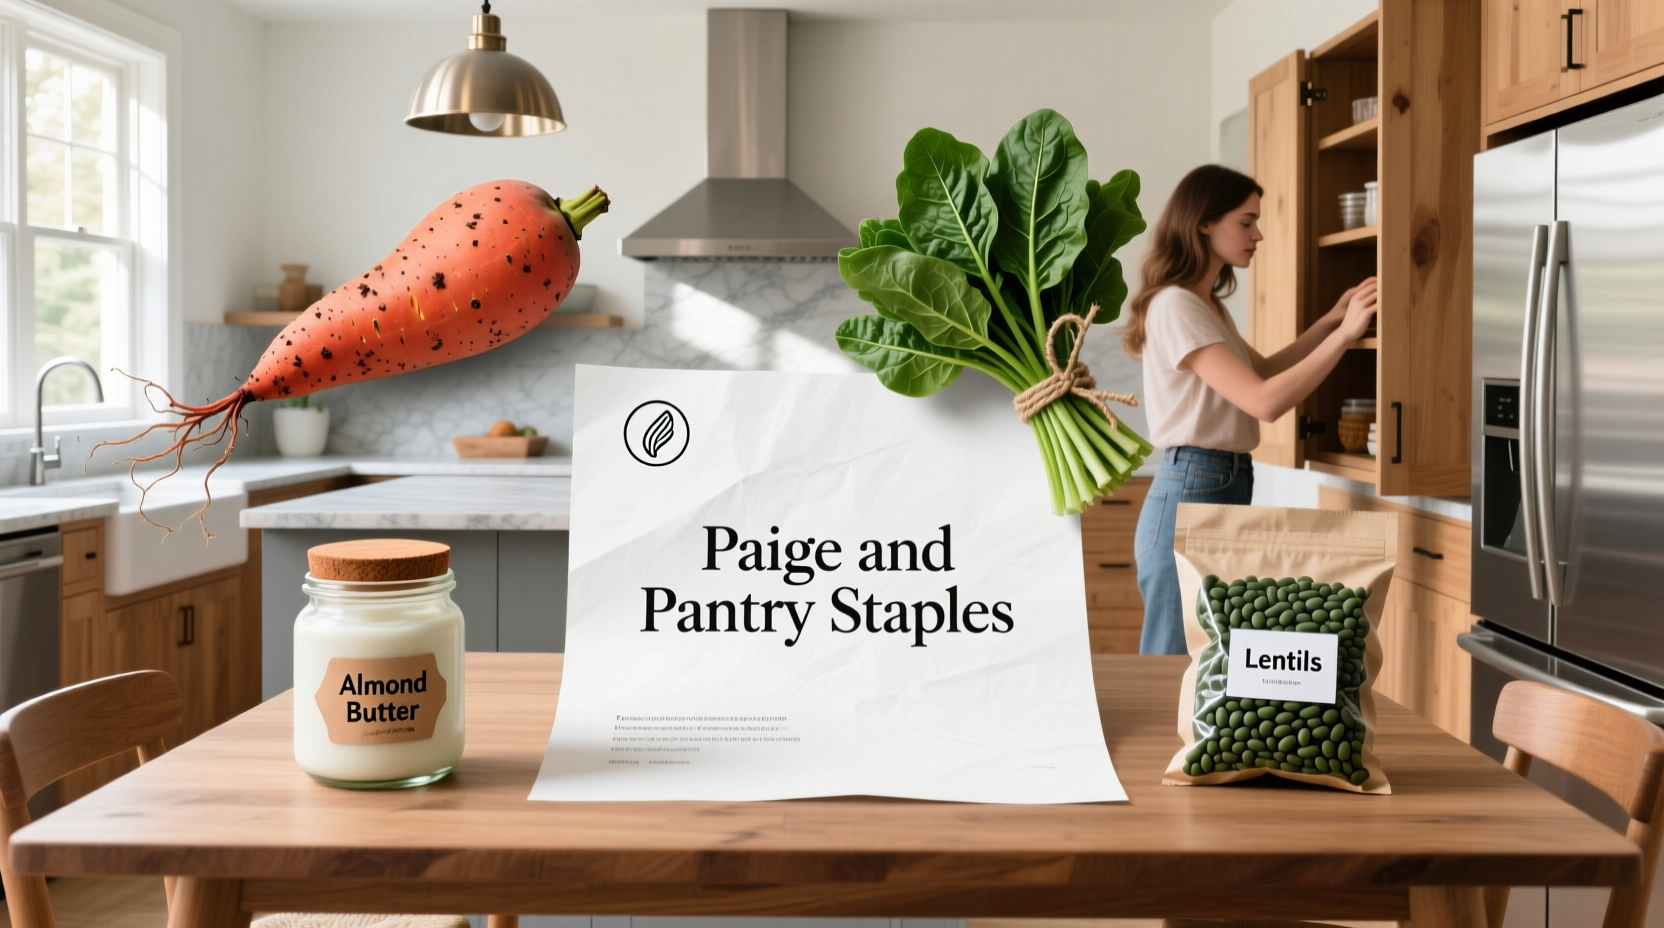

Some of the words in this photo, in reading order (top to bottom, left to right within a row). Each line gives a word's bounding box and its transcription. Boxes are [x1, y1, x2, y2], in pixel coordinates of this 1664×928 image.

[701, 525, 842, 586] Paige
[858, 523, 956, 572] and
[640, 586, 816, 648] Pantry
[831, 585, 1014, 648] Staples
[1245, 648, 1322, 672] Lentils
[339, 669, 427, 696] Almond
[346, 701, 420, 723] Butter
